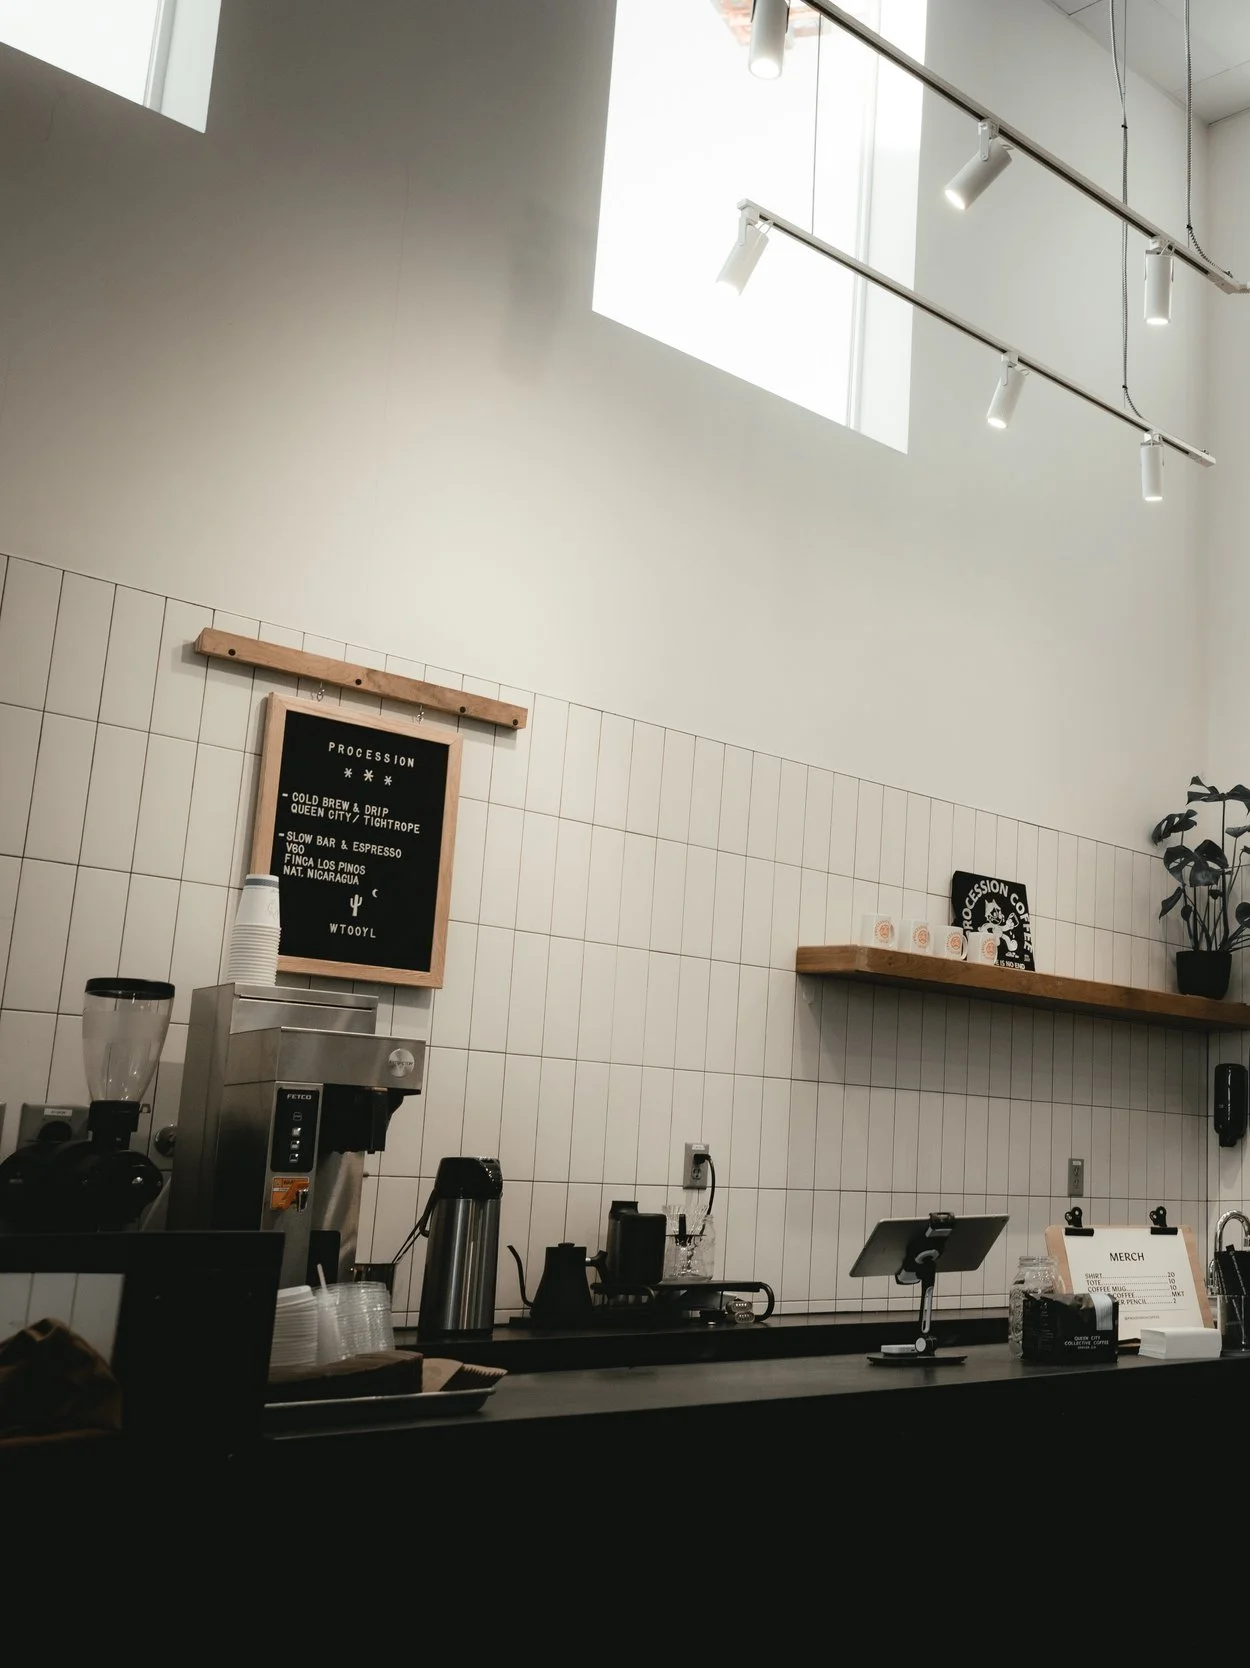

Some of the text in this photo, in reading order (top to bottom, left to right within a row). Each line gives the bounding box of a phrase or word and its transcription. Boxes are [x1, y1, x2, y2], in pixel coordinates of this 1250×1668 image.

[328, 742, 414, 768] PROCESSION
[292, 792, 319, 805] COLD
[322, 797, 350, 811] BREW
[353, 803, 360, 813] &
[365, 804, 389, 817] DRIP
[291, 803, 324, 817] QUEEN
[363, 815, 420, 834] TIGHTROPE
[316, 835, 336, 848] BAR
[341, 840, 348, 850] &
[353, 841, 402, 858] ESPRESSO
[283, 865, 359, 885] NAT. NICARAGUA
[284, 853, 366, 875] FINCA LOS PINOS
[962, 880, 1009, 932] ROCESSION
[1010, 893, 1033, 953] COFFEE
[1110, 1252, 1145, 1262] MERCH
